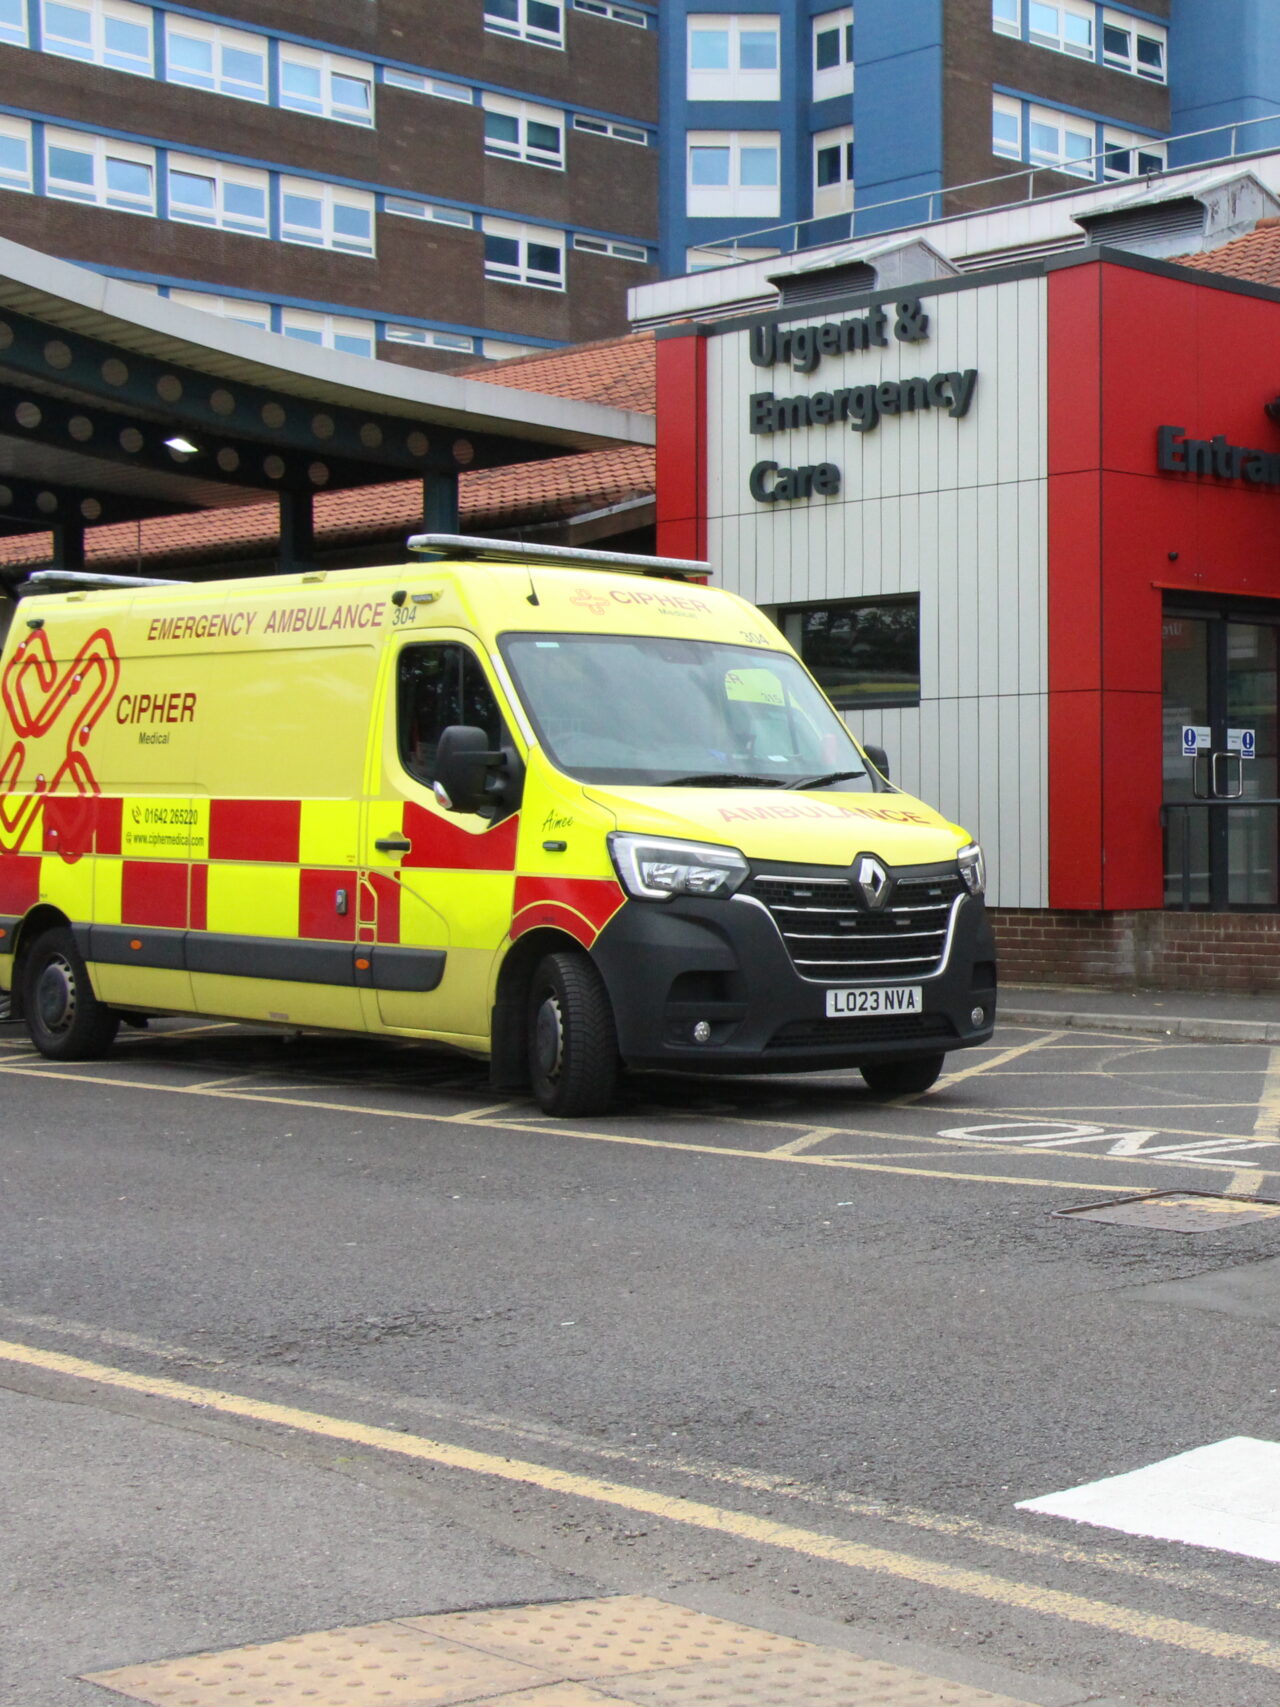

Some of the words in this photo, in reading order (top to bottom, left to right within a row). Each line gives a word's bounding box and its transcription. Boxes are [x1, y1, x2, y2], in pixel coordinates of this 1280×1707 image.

[750, 304, 888, 373] Urgent
[894, 297, 930, 343] &
[750, 369, 978, 434] Emergency
[750, 460, 841, 503] Care
[609, 590, 712, 614] CIPHER
[147, 611, 256, 641] EMERGENCY
[264, 602, 387, 634] AMBULANCE
[392, 606, 417, 626] 304
[739, 630, 769, 646] 304
[116, 693, 197, 725] CIPHER
[139, 731, 170, 745] Medical
[144, 808, 167, 824] 01642
[169, 809, 198, 825] 265220
[541, 809, 574, 832] Aimee
[717, 806, 932, 825] AMBULANCE
[884, 989, 915, 1010] NVA
[937, 1122, 1280, 1168] ONL
